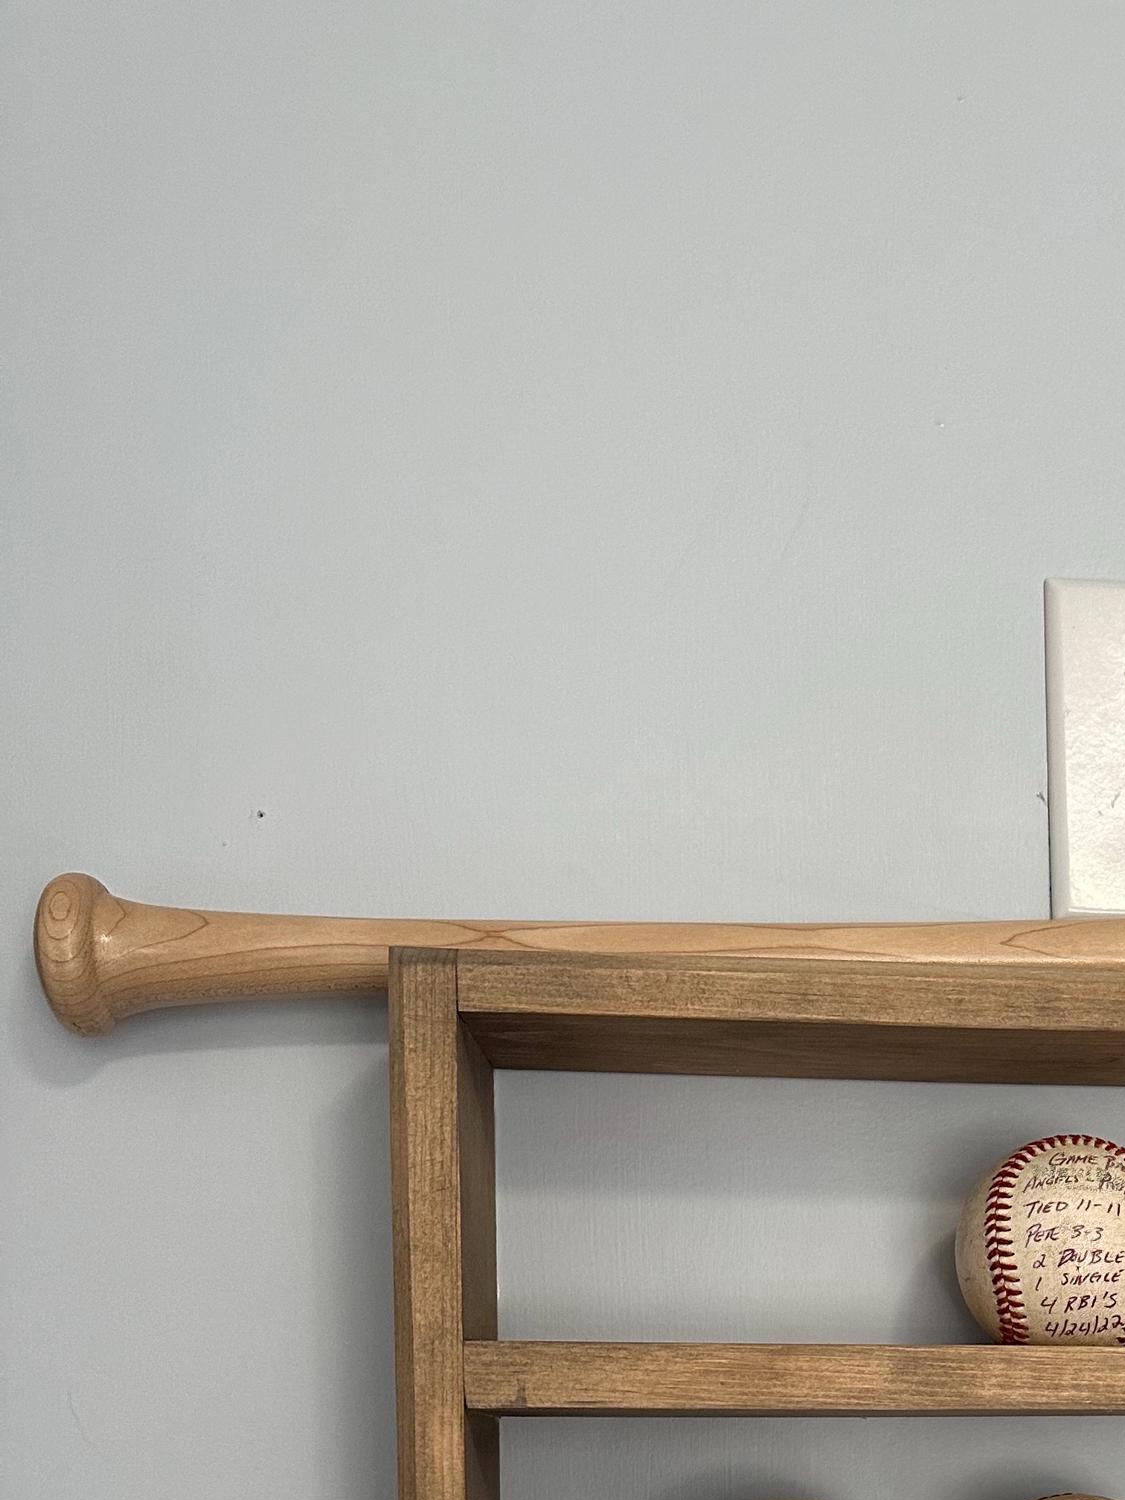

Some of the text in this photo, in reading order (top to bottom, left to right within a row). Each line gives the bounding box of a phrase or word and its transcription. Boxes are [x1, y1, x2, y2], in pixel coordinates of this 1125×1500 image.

[1048, 1151, 1099, 1167] GAME
[1024, 1200, 1122, 1220] TIED 11-11
[1070, 1226, 1104, 1242] 3-3
[1032, 1255, 1047, 1269] 2
[1035, 1269, 1124, 1292] 1 SINGLE
[1040, 1292, 1119, 1315] 4 RBI'S
[1045, 1315, 1125, 1338] 4/24/22
